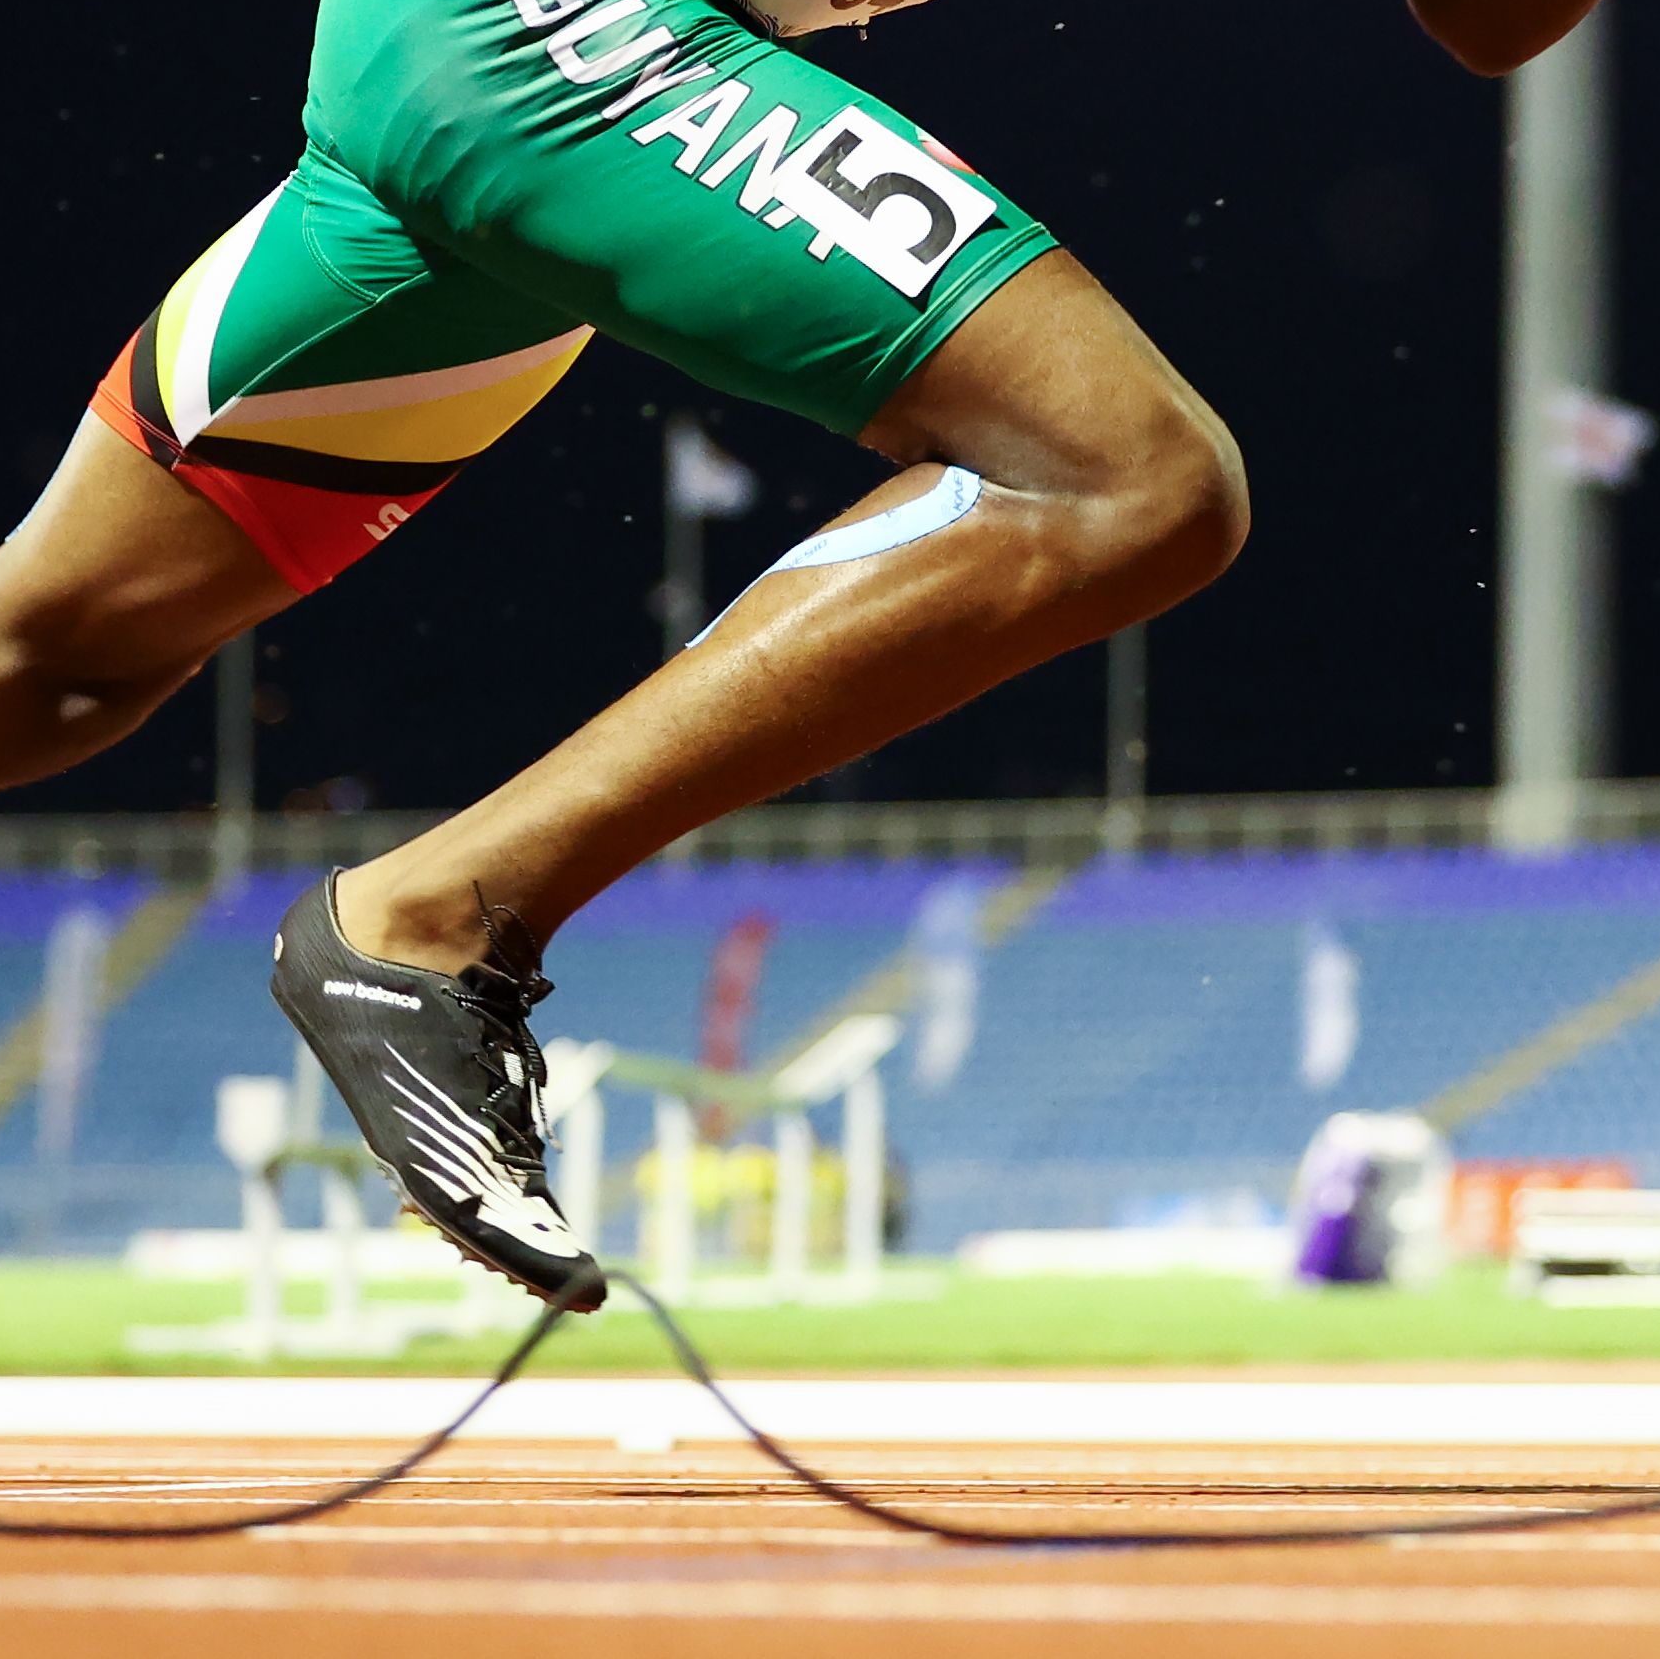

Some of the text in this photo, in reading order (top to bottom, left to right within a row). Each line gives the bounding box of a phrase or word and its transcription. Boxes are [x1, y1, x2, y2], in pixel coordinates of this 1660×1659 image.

[805, 128, 957, 266] 5
[323, 980, 422, 1011] new balance
